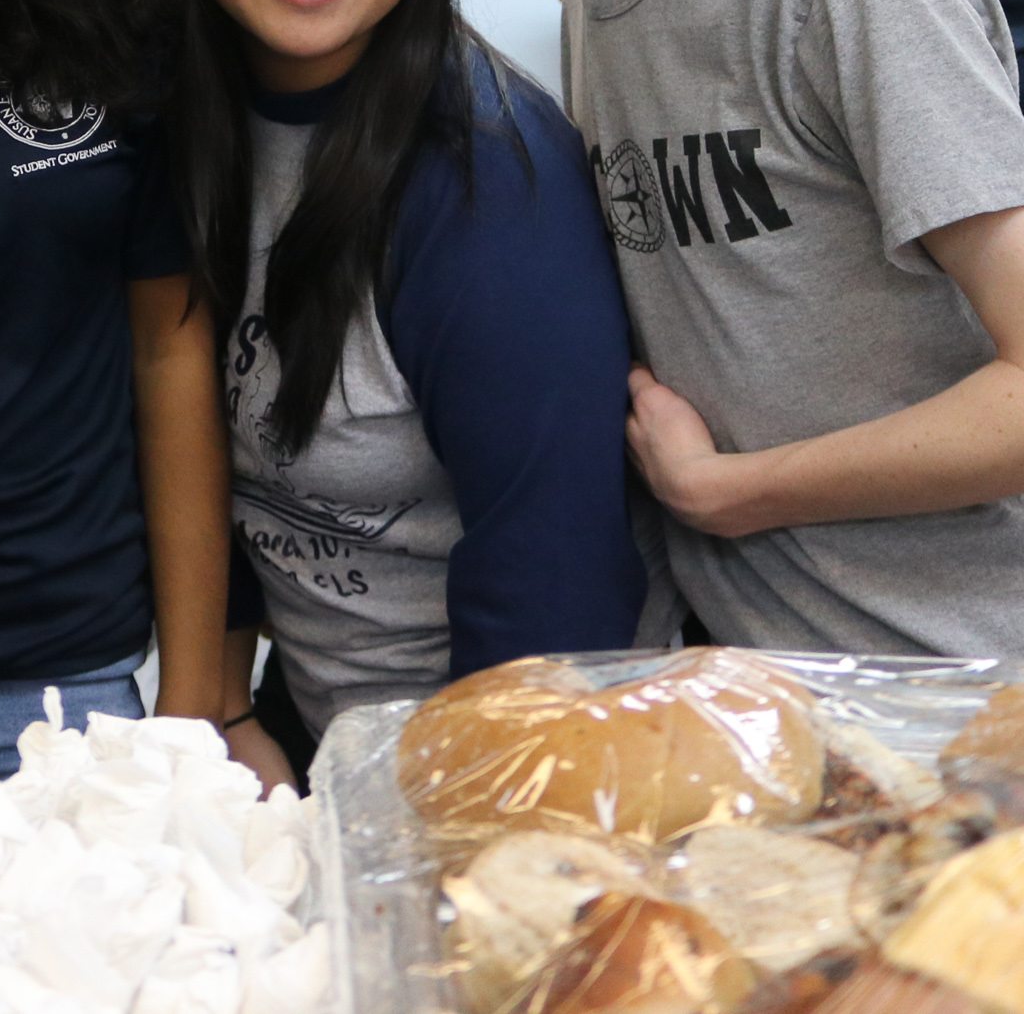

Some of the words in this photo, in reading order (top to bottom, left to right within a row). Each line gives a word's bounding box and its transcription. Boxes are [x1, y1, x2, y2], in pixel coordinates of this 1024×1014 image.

[0, 108, 38, 140] SUSAN
[12, 157, 57, 177] STUDENT
[58, 140, 118, 165] GOVERNMENT
